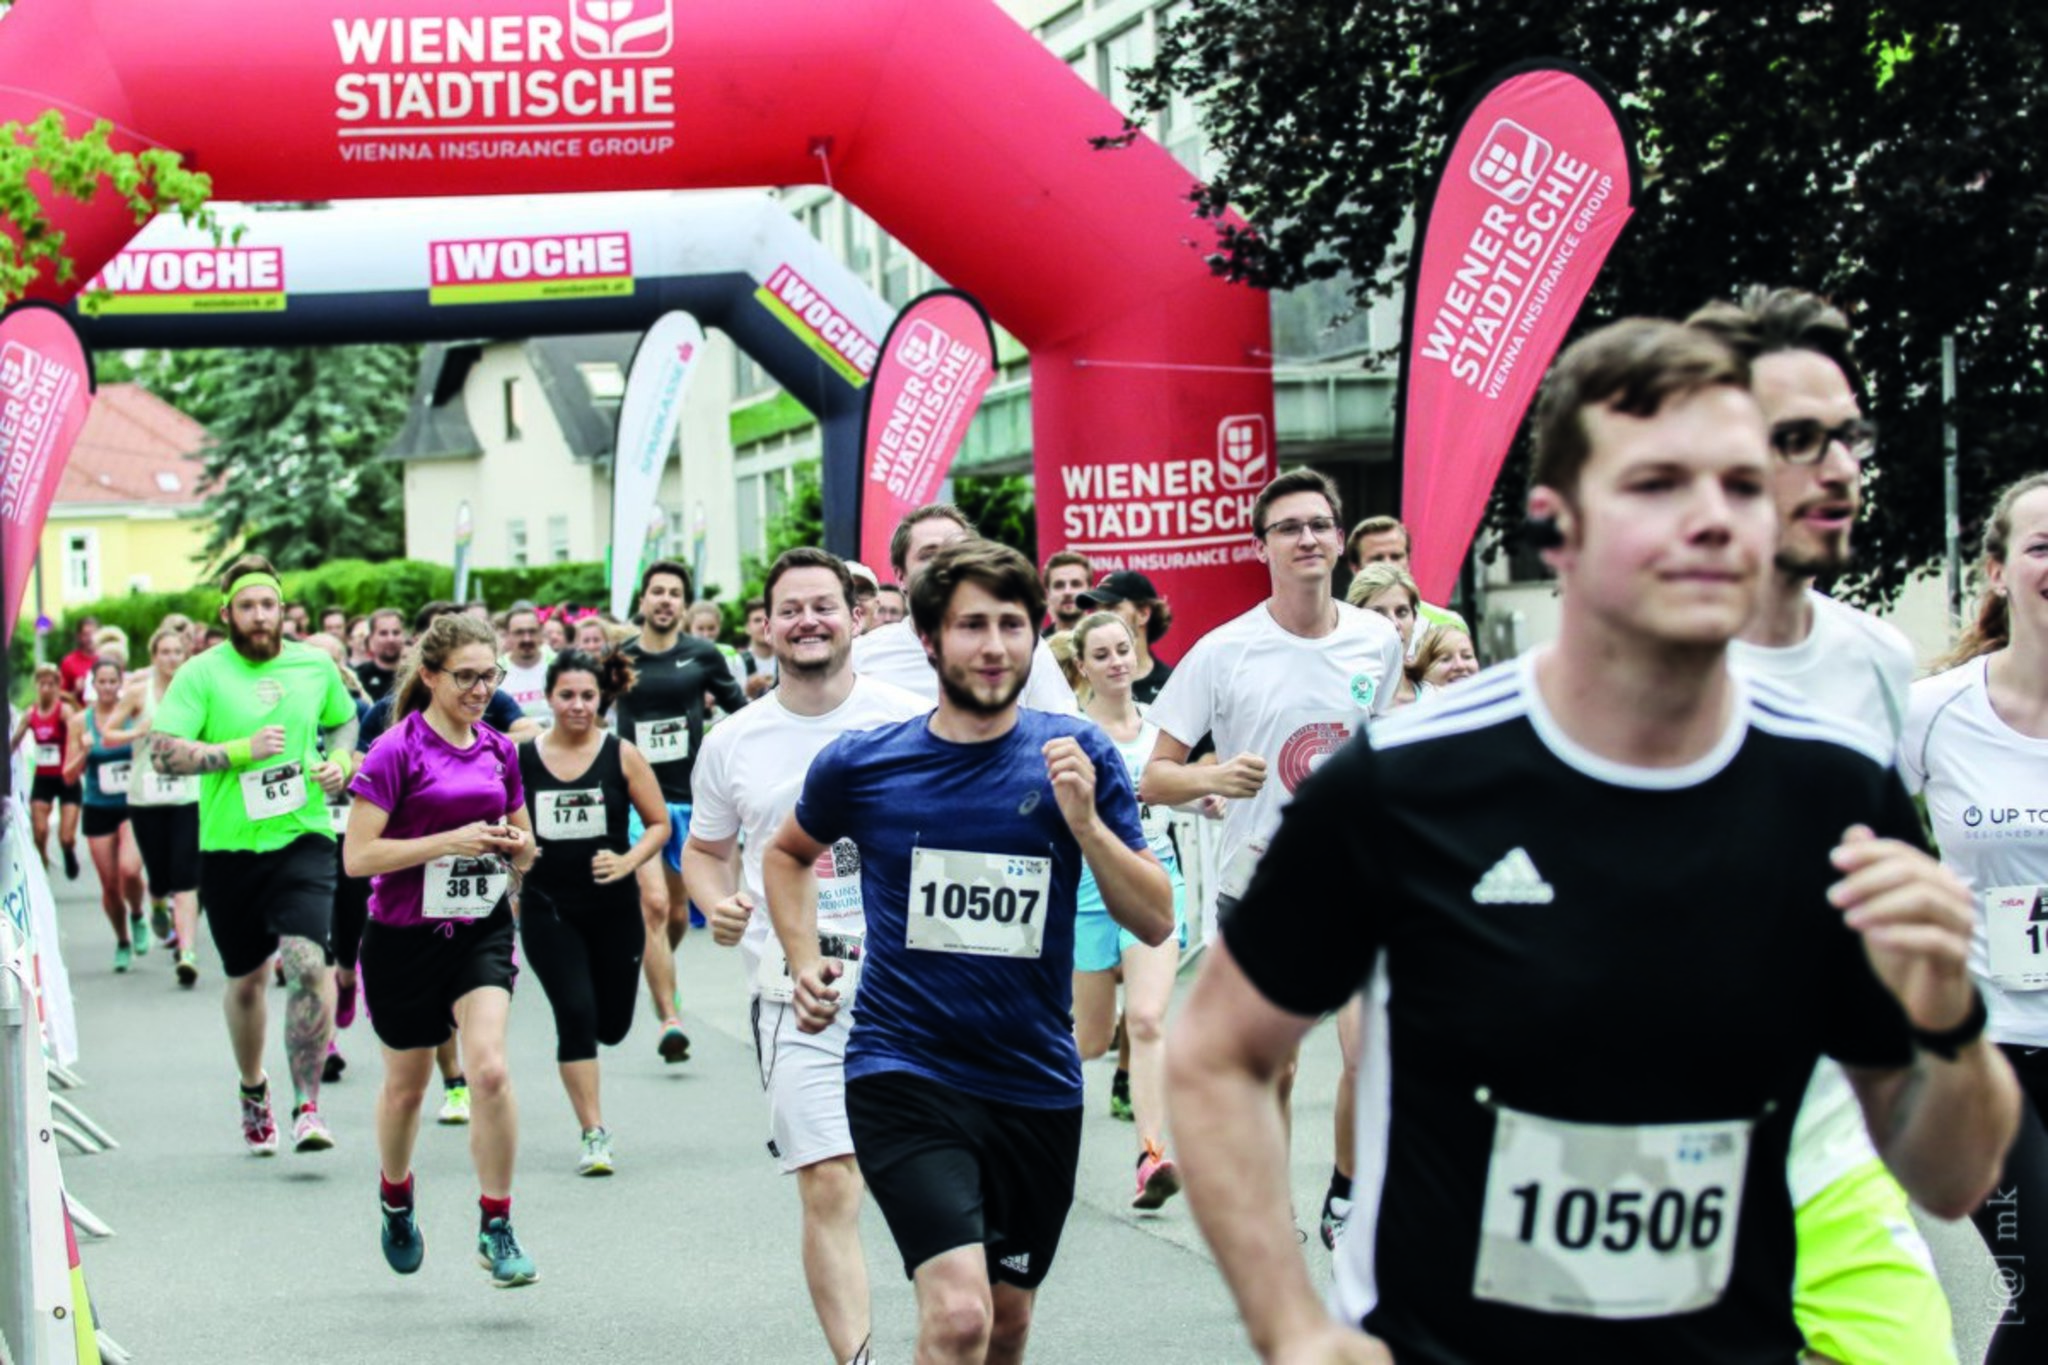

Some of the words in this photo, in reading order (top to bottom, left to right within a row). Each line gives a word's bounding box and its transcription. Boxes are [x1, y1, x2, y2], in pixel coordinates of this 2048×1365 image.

[332, 16, 564, 64] WIENER
[334, 67, 675, 121] STÄDTISCHE
[339, 141, 434, 162] VIENNA
[440, 138, 582, 160] INSURANCE
[589, 136, 675, 156] GROUP
[1421, 203, 1517, 363] WIENER
[1450, 150, 1589, 387] STÄDTISCHE
[1486, 336, 1526, 401] VIENNA
[1519, 233, 1581, 336] INSURANCE
[1575, 174, 1615, 235] GROUP
[869, 375, 927, 483] WIENER
[886, 339, 972, 498] STÄDTISCHE
[1061, 458, 1216, 500] WIENER
[1064, 494, 1255, 539] STÄDTISCH
[1128, 547, 1229, 570] INSURANCE
[650, 735, 665, 749] 31
[669, 734, 678, 747] A
[265, 786, 276, 800] 6
[280, 782, 291, 797] C
[553, 807, 572, 825] 17
[577, 808, 589, 823] A
[1989, 809, 2019, 824] UP
[446, 879, 470, 898] 38
[476, 876, 489, 897] B
[920, 881, 1040, 924] 10507
[1512, 1181, 1725, 1254] 10506
